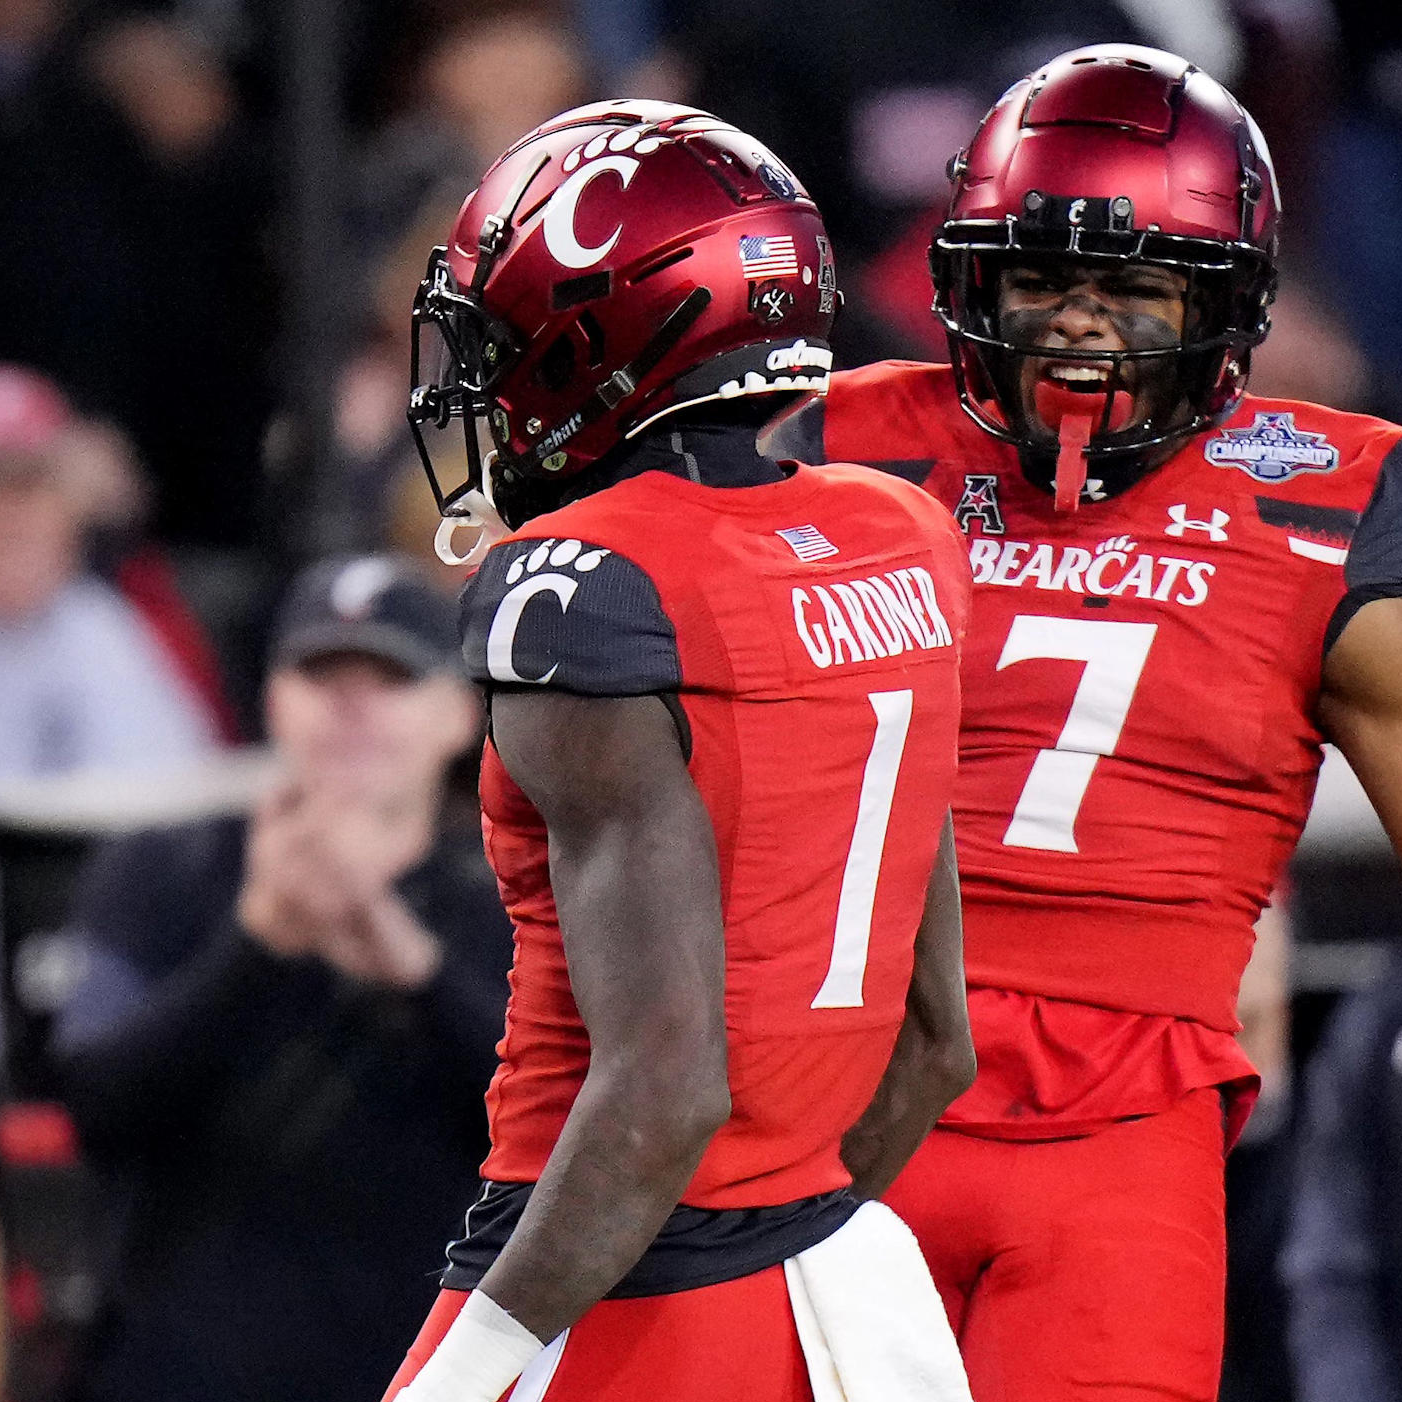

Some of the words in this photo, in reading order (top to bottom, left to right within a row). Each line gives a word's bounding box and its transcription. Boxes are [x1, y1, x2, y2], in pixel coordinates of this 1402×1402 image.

[791, 566, 953, 669] GARDNER
[968, 536, 1217, 606] BEARCATS
[487, 572, 579, 685] C
[996, 614, 1158, 854] 7
[810, 688, 913, 1010] 1
